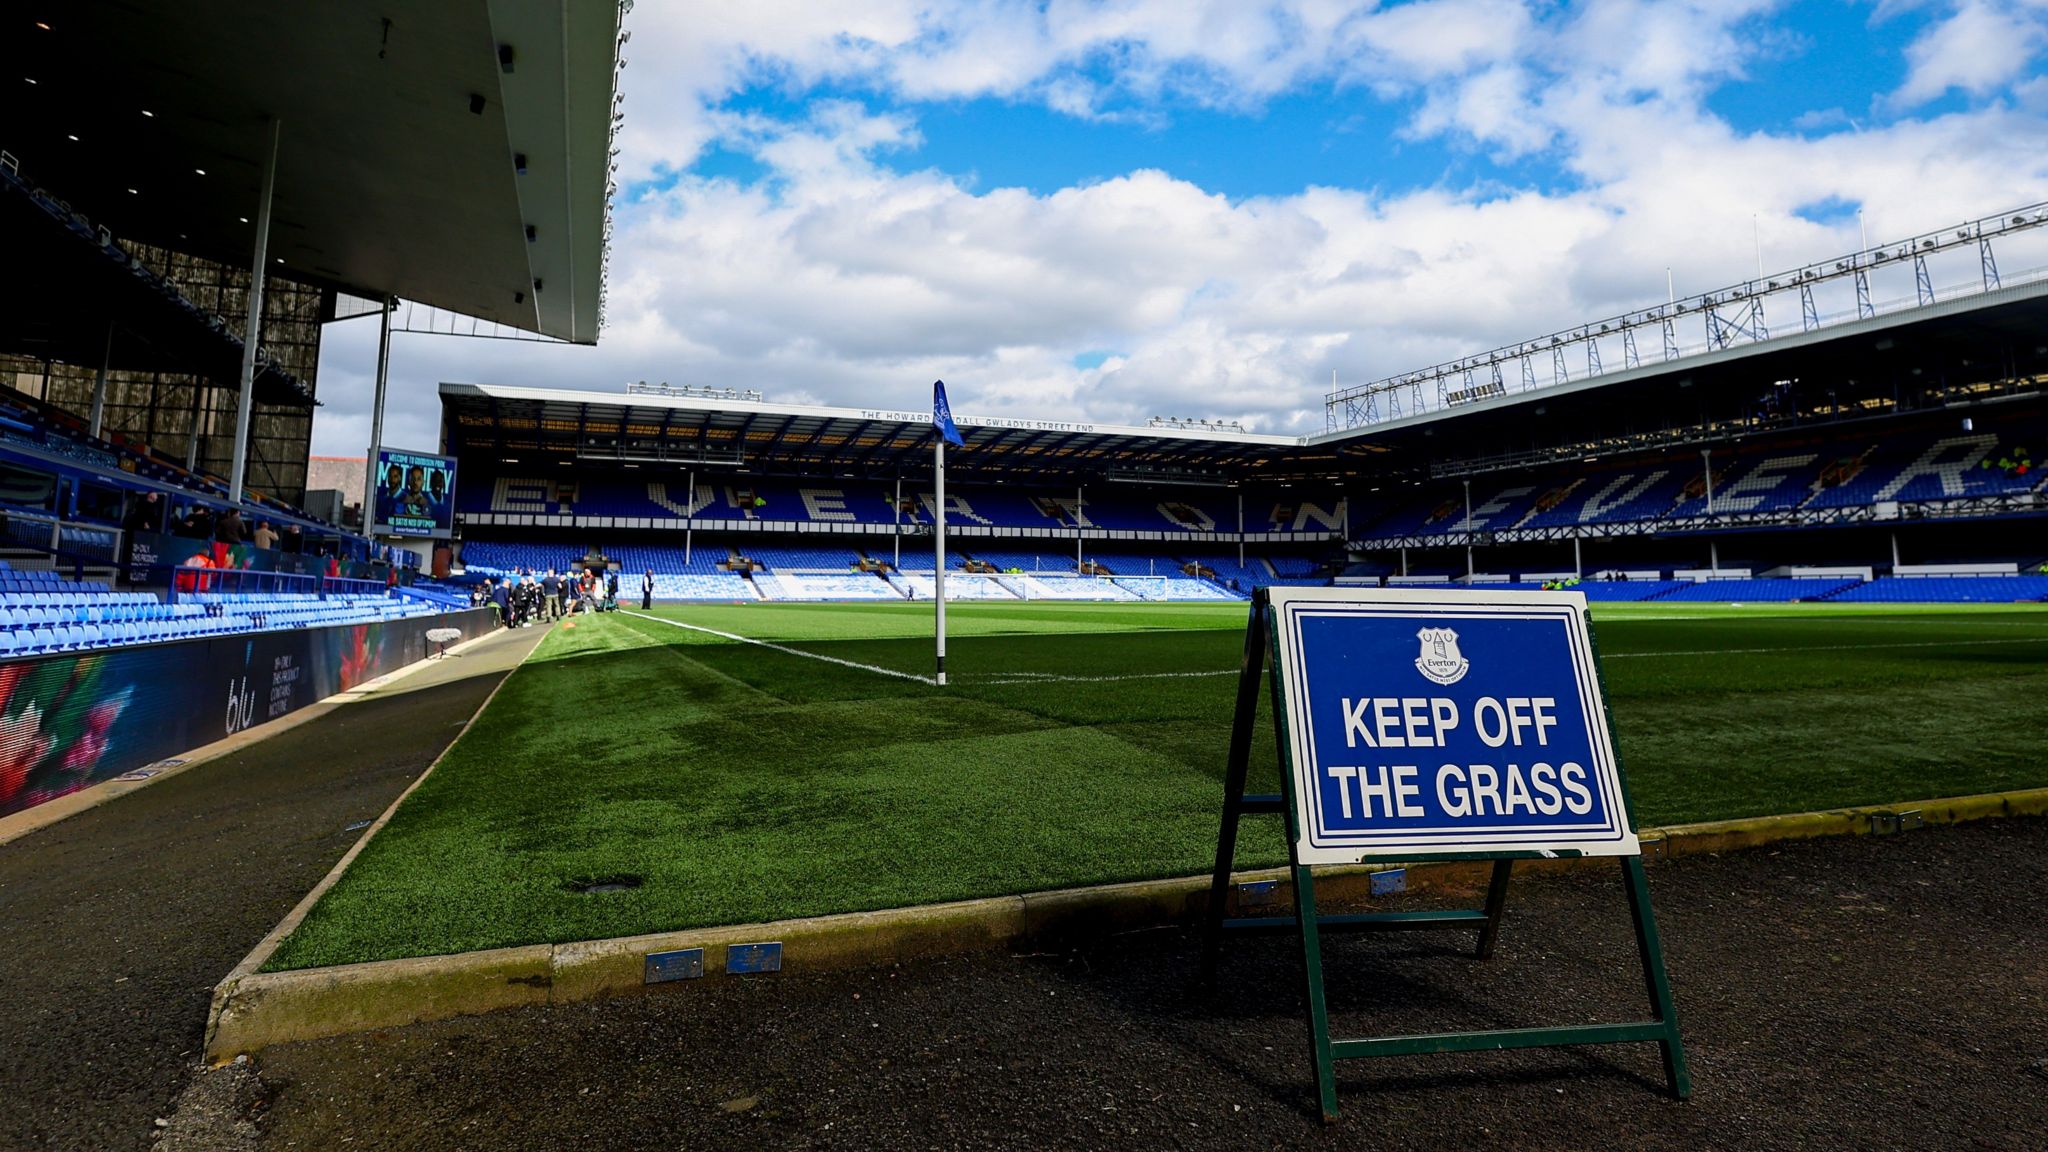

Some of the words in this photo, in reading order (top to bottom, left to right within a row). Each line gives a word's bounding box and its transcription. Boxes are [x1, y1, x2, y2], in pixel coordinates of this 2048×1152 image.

[861, 411, 880, 419] THE
[886, 412, 930, 422] HOWARD
[985, 418, 1031, 428] GWLADYS
[1036, 421, 1071, 431] STREET
[1076, 424, 1094, 432] END
[1427, 658, 1457, 667] Everton
[226, 676, 255, 734] blu
[1342, 697, 1459, 747] KEEP
[1474, 696, 1557, 747] OFF
[1328, 765, 1425, 818] THE
[1436, 762, 1593, 817] GRASS
